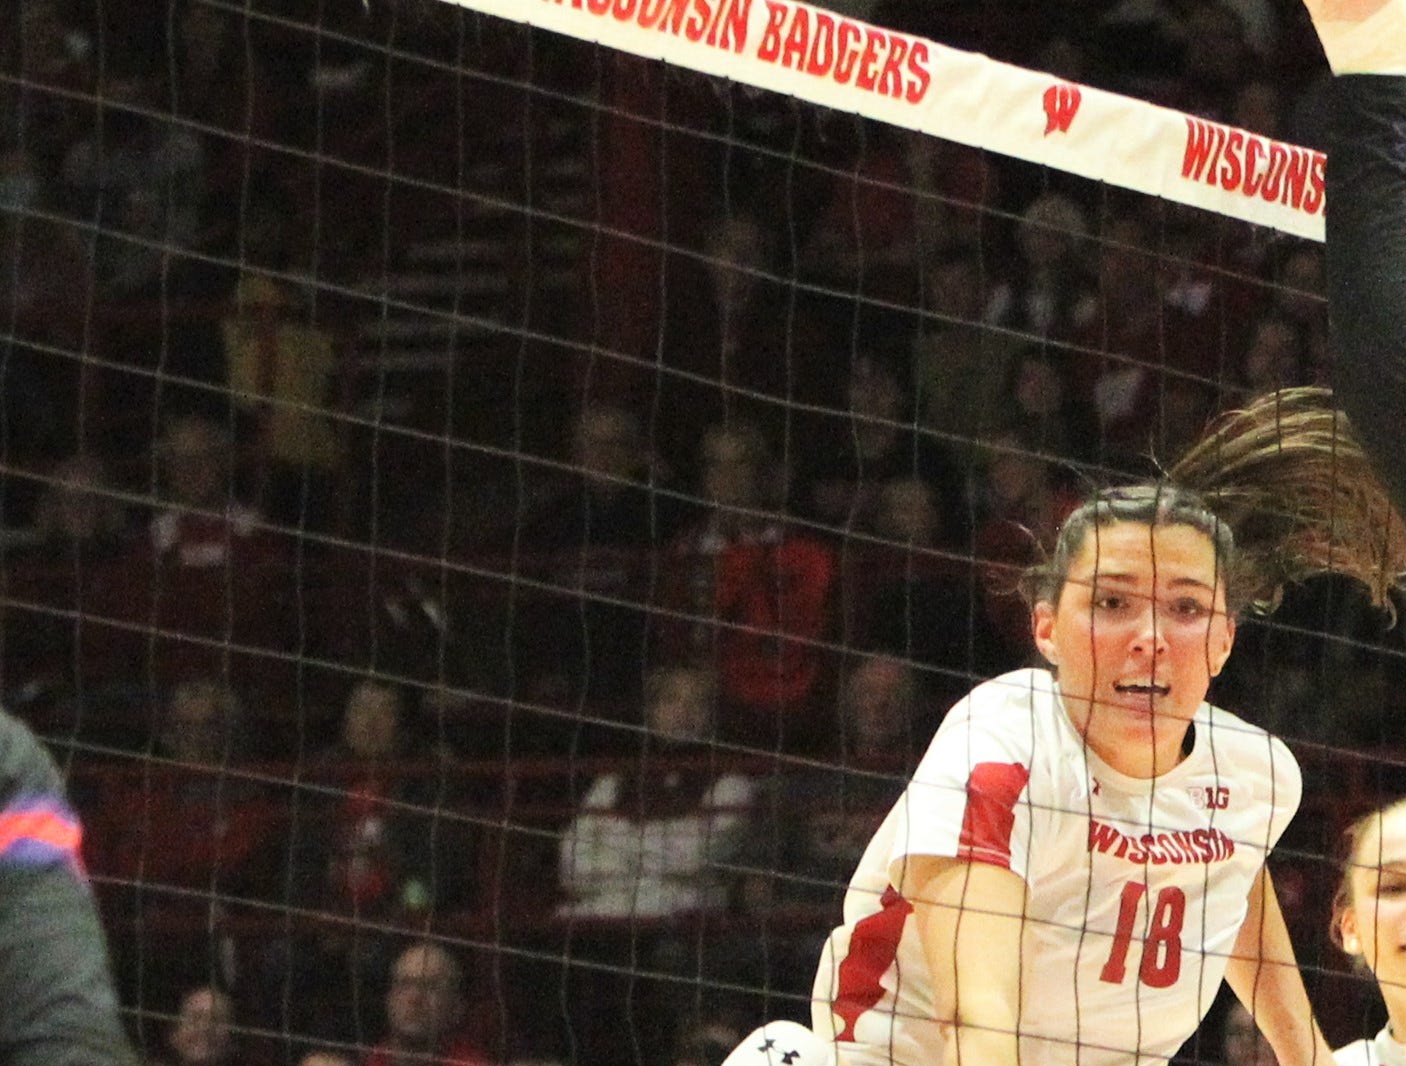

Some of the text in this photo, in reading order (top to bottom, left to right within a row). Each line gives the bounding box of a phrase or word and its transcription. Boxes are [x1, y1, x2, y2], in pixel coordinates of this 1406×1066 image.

[758, 1, 931, 105] BADGERS
[1181, 117, 1327, 216] WISCONS
[1088, 820, 1236, 865] WISCONSIN
[1099, 881, 1186, 989] 18
